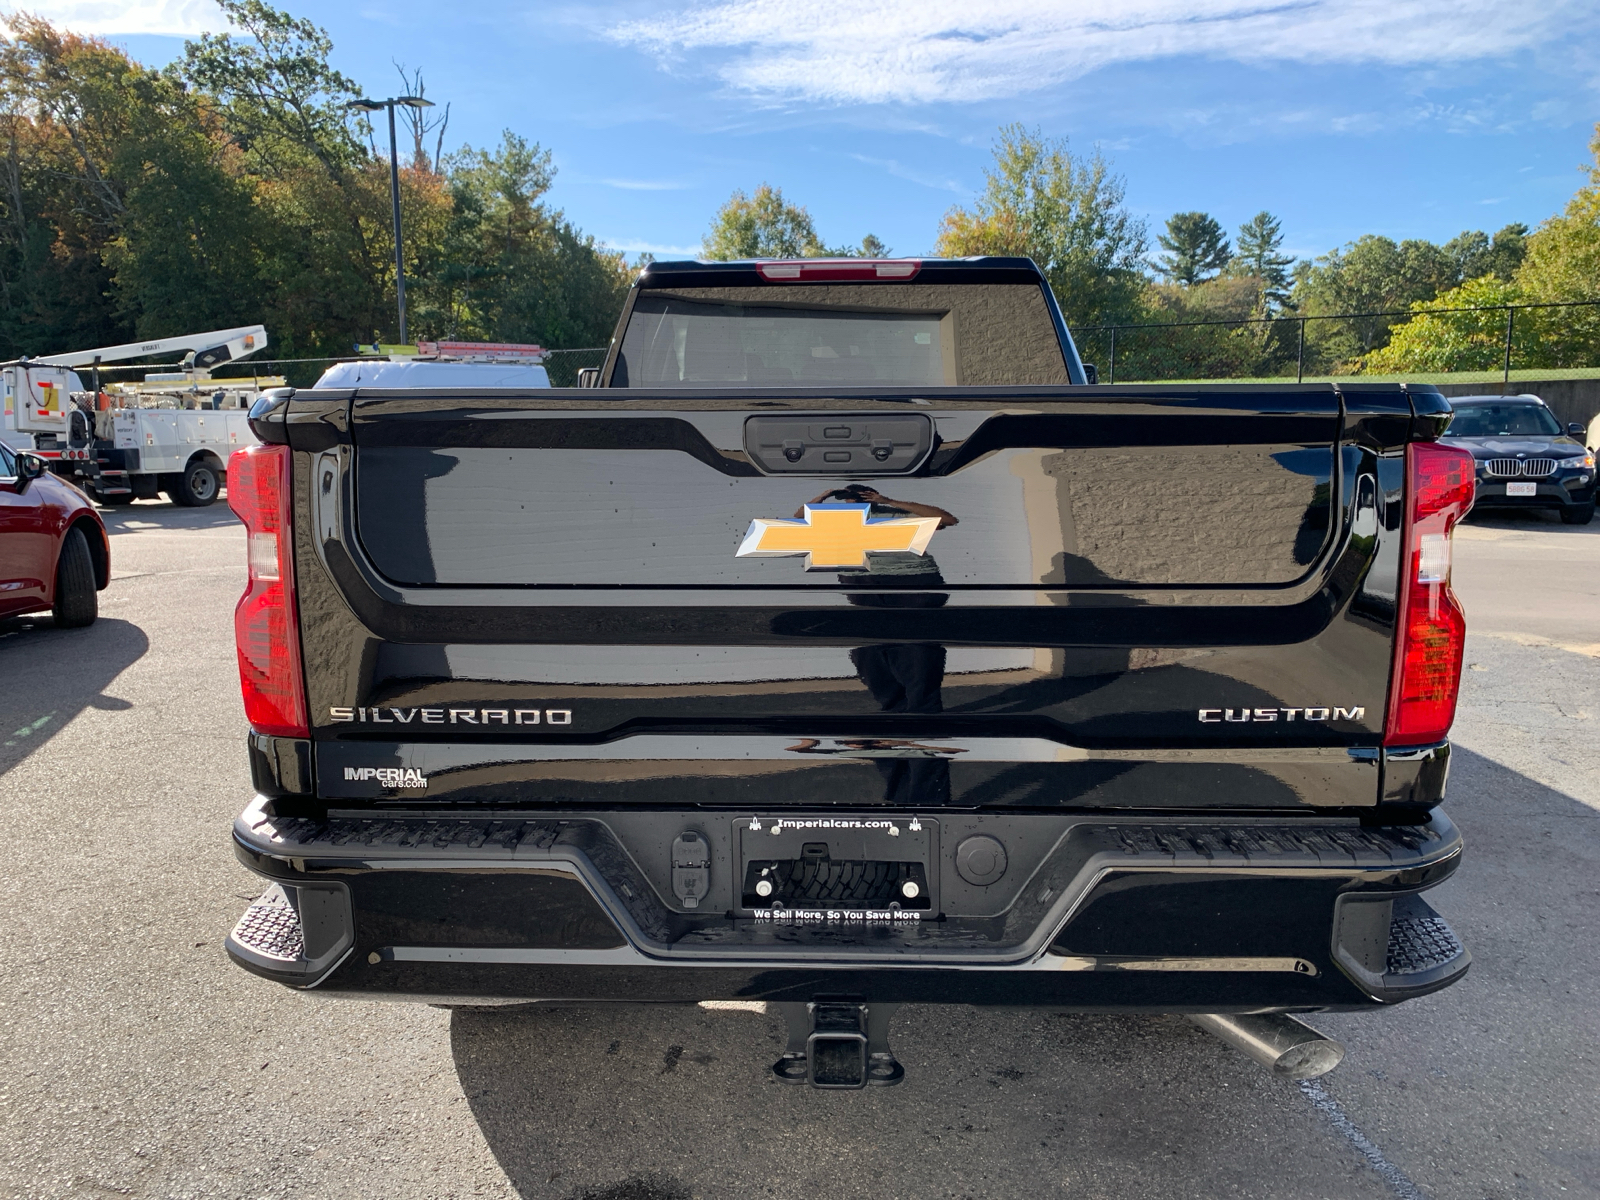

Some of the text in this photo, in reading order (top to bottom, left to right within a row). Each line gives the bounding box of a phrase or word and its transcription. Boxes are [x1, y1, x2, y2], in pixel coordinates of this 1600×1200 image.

[330, 706, 572, 725] SILVERADO
[1198, 706, 1365, 722] CUSTOM
[344, 767, 427, 782] IMPERIAL
[382, 780, 427, 788] cars.com
[777, 819, 893, 829] Imperialcars.com
[754, 910, 920, 920] We Sell More, So You Save More
